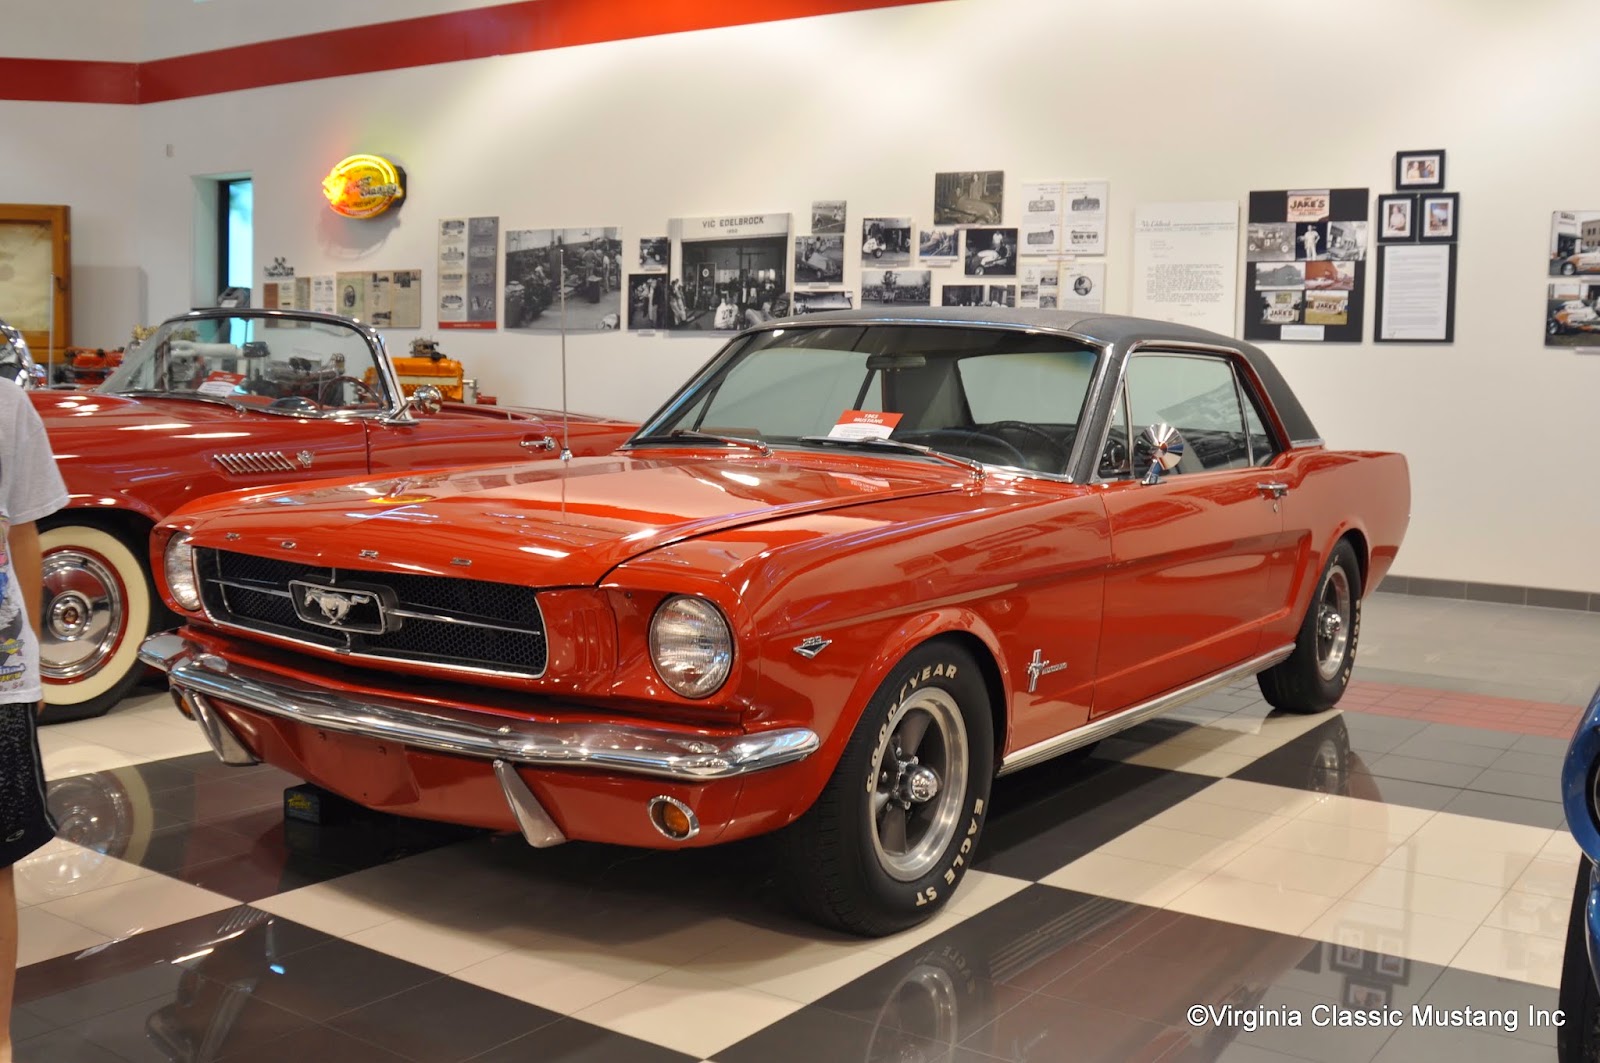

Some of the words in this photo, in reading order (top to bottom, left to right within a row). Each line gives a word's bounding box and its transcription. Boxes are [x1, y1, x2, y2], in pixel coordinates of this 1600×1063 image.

[1290, 199, 1325, 209] JAKE'S
[702, 219, 716, 228] VIC
[719, 215, 764, 227] EDELBROCK
[866, 664, 957, 793] GOODYEAR
[944, 798, 984, 886] EAGLE
[915, 886, 937, 906] ST
